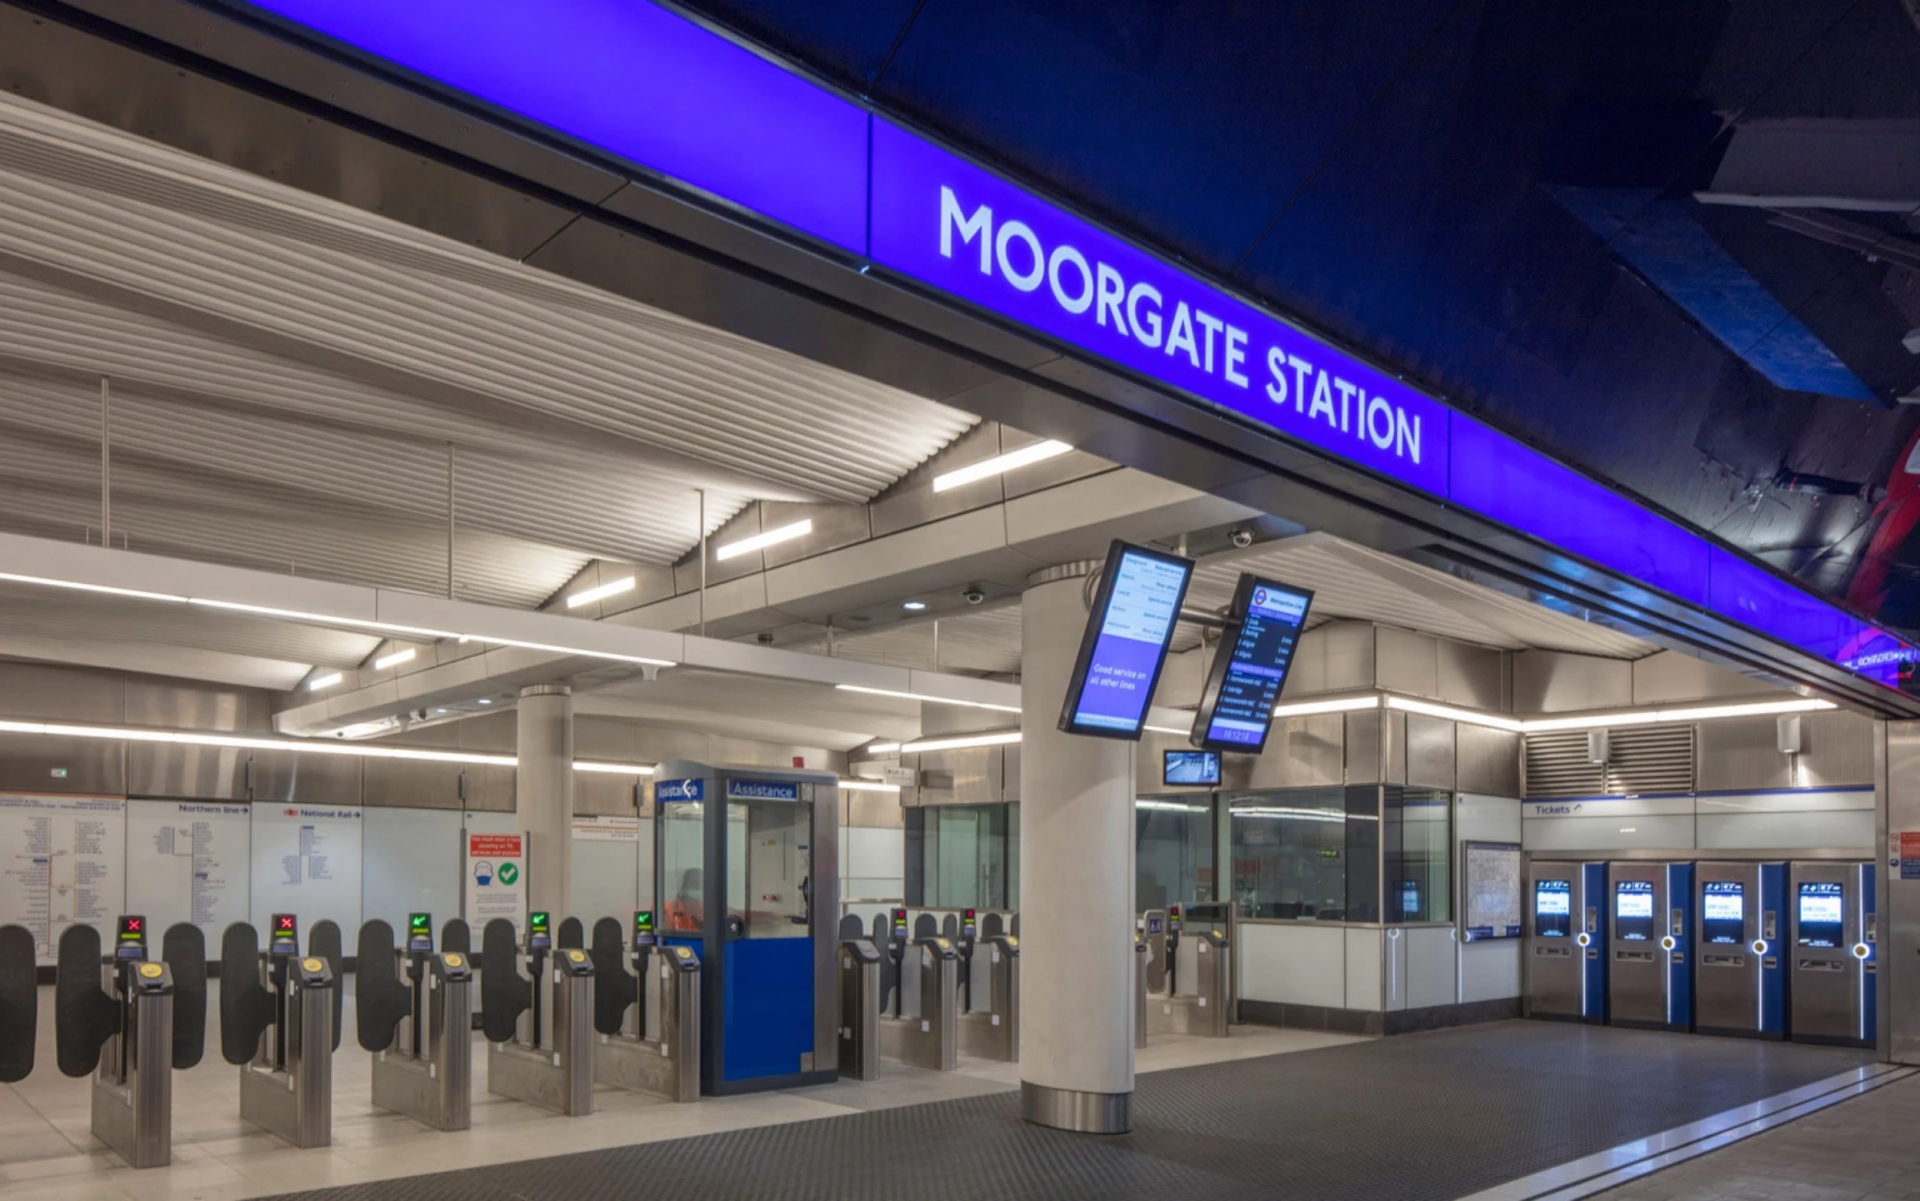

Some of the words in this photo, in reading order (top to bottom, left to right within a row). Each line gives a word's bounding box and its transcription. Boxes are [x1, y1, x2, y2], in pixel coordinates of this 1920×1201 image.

[940, 185, 1249, 389] MOORGATE
[1266, 347, 1420, 464] STATION
[1094, 663, 1113, 675] Good
[1113, 668, 1137, 679] service
[1137, 672, 1147, 680] on
[1090, 676, 1100, 684] all
[1100, 678, 1119, 688] other
[1119, 680, 1136, 691] lines
[734, 783, 793, 798] Assistance
[179, 804, 221, 814] Northern
[223, 806, 239, 815] line
[300, 810, 335, 819] National
[337, 811, 352, 819] Rail
[1536, 805, 1571, 815] Tickets
